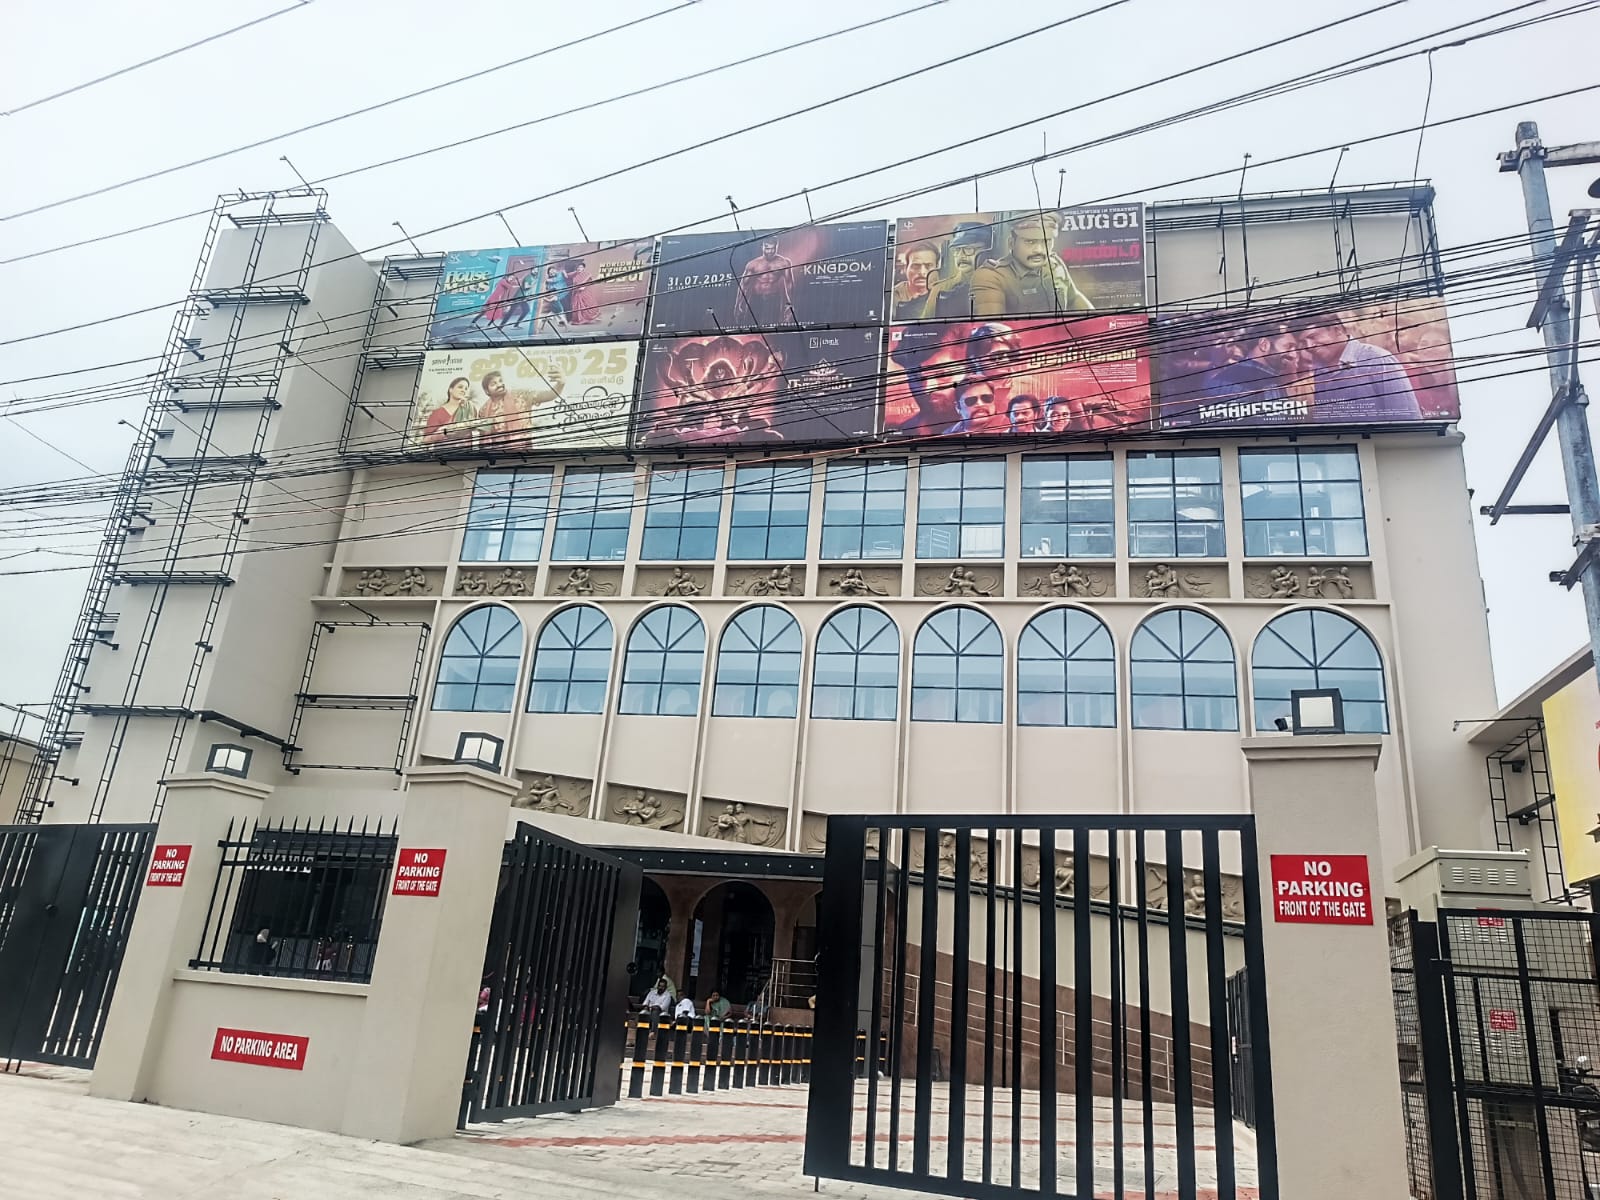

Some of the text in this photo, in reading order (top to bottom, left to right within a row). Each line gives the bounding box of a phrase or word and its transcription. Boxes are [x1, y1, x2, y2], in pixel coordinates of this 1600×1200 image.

[1061, 211, 1139, 231] AUG 01
[803, 261, 872, 275] KINGDOM
[667, 273, 733, 287] 31.07.2025
[580, 348, 628, 375] 25
[166, 849, 178, 858] NO
[414, 853, 428, 863] NO
[152, 860, 185, 870] PARKING
[398, 866, 440, 877] PARKING
[1303, 861, 1332, 876] NO
[395, 880, 438, 892] FRONT OF THE GATE
[1277, 881, 1364, 897] PARKING
[1279, 900, 1366, 918] FRONT OF THE GATE
[220, 1035, 298, 1061] NO PARKING AREA
